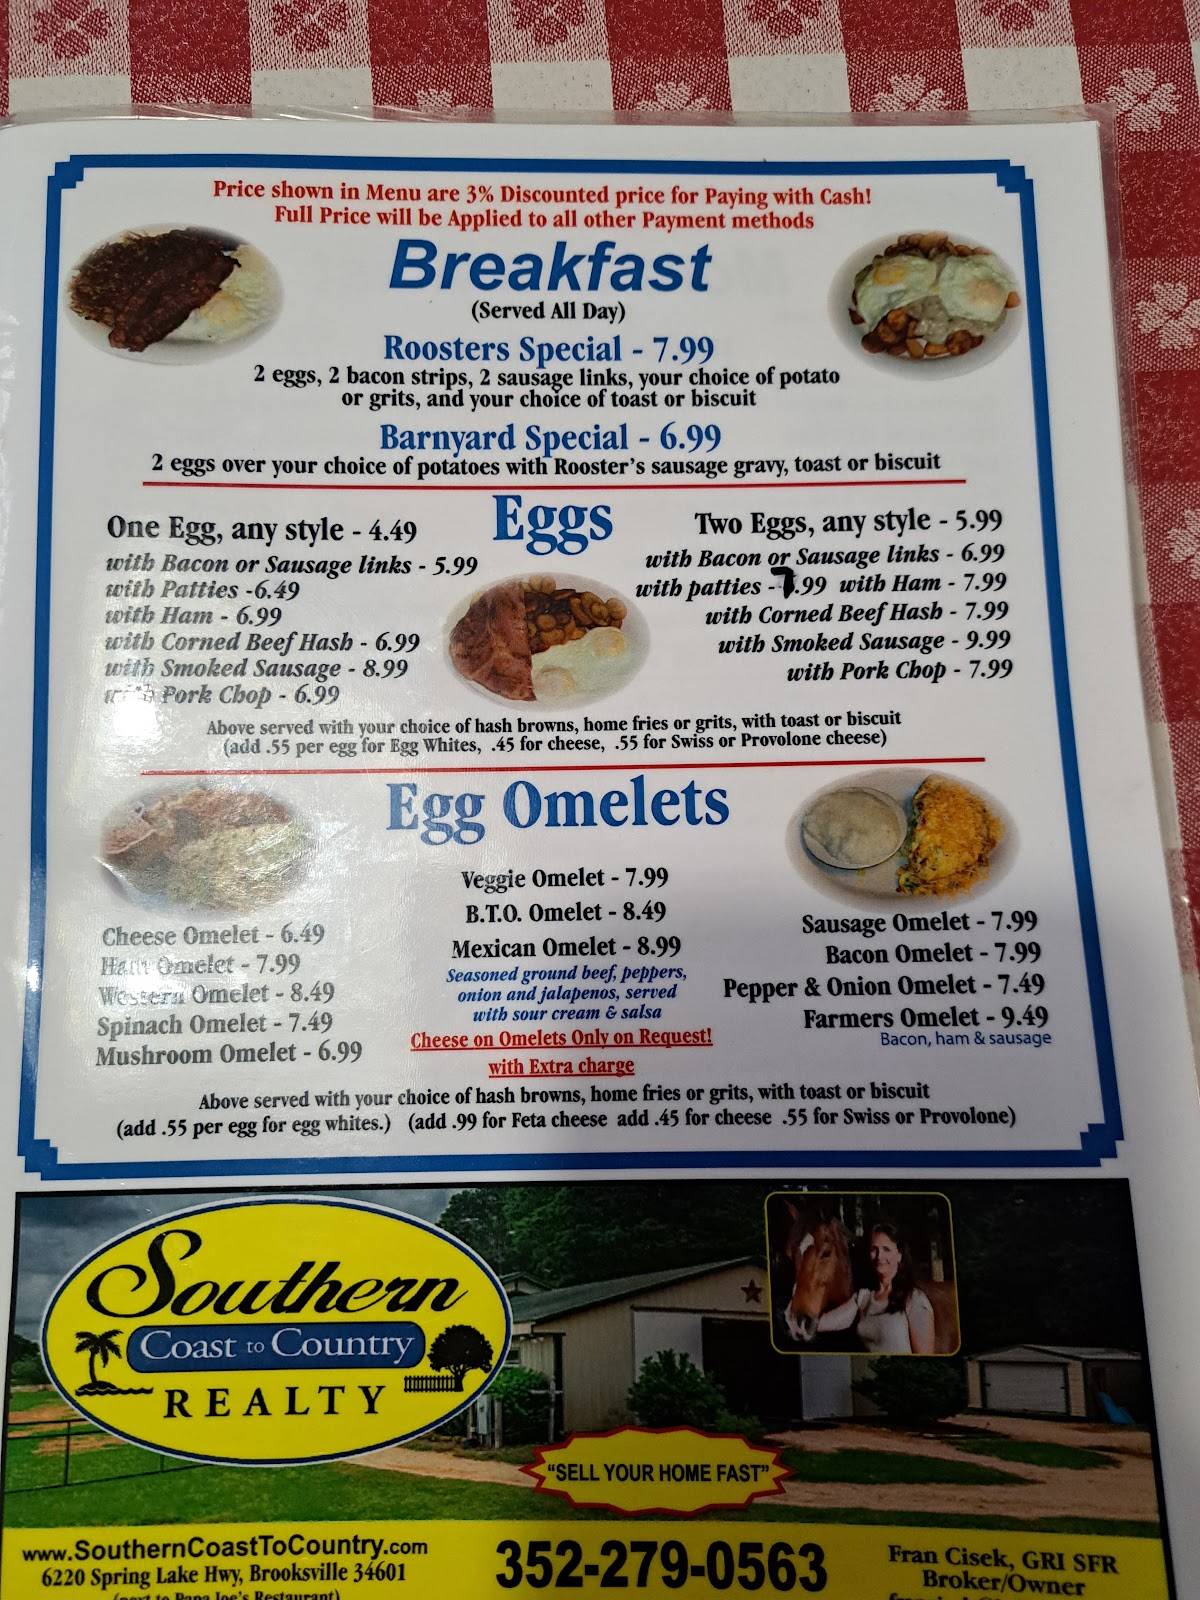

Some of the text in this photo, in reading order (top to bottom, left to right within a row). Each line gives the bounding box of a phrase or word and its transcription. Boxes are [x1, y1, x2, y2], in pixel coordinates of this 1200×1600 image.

[214, 180, 870, 209] Price shown in Menu are 3% Discounted price for Paying with Cash!
[275, 205, 814, 233] Full Price will be Applied to all other Payment methods
[389, 239, 712, 291] Breakfast
[472, 300, 625, 324] (Served All Day)
[384, 335, 509, 361] Roosters
[520, 335, 621, 369] Special
[654, 337, 713, 365] 7.99
[254, 365, 840, 391] 2 eggs, 2 bacon strips, 2 sausage links, your choice of potato
[342, 388, 756, 412] or grits, and your choice of toast or biscuit
[380, 423, 516, 459] Barnyard
[526, 423, 628, 458] Special
[660, 421, 721, 453] 6.99
[108, 515, 159, 538] One
[169, 516, 222, 546] Egg,
[232, 522, 278, 547] any
[286, 517, 344, 547] style
[369, 519, 417, 544] 4.49
[492, 495, 613, 555] Eggs
[694, 513, 742, 534] Two
[750, 512, 814, 540] Eggs,
[823, 515, 866, 538] any
[874, 507, 931, 537] style
[956, 510, 1002, 532] 5.99
[107, 579, 154, 598] with
[161, 581, 238, 598] Patties
[636, 578, 682, 598] with
[685, 576, 761, 601] patties
[840, 574, 886, 593] with
[891, 575, 941, 592] Ham
[964, 573, 1007, 592] 7.99
[387, 775, 729, 845] Egg Omelets
[461, 869, 525, 894] Veggie
[532, 867, 605, 887] Omelet
[626, 867, 668, 888] 7.99
[802, 915, 887, 938] Sausage
[893, 911, 970, 932] Omelet
[991, 911, 1037, 932] 7.99
[452, 939, 536, 958] Mexican
[543, 936, 616, 956] Omelet
[638, 936, 681, 957] 8.99
[446, 964, 686, 985] Seasoned ground beef, peppers,
[458, 984, 677, 1004] onion and jalapenos, served
[98, 1014, 182, 1041] Spinach
[190, 1013, 266, 1033] Omelet
[289, 1011, 332, 1033] 7.49
[473, 1004, 662, 1021] with sour cream & salsa
[411, 1028, 713, 1050] Cheese on Omelets Only on Request!
[881, 1031, 1051, 1047] Bacon, ham & sausage
[488, 1058, 635, 1077] with Extra charge
[86, 1229, 468, 1318] Southern
[140, 1328, 416, 1364] Coast to Country
[163, 1386, 386, 1418] REALTY
[604, 1464, 654, 1482] YOUR
[659, 1465, 712, 1482] HOME
[22, 1534, 427, 1561] www.SouthernCoastToCountry.com
[888, 1544, 1118, 1574] Fran Cisek, GRI SFR
[42, 1561, 406, 1591] 6220 Spring Lake Hwy, Brooksville 34601
[496, 1540, 827, 1592] 352-279-0563
[923, 1569, 1086, 1596] Broker/Owner
